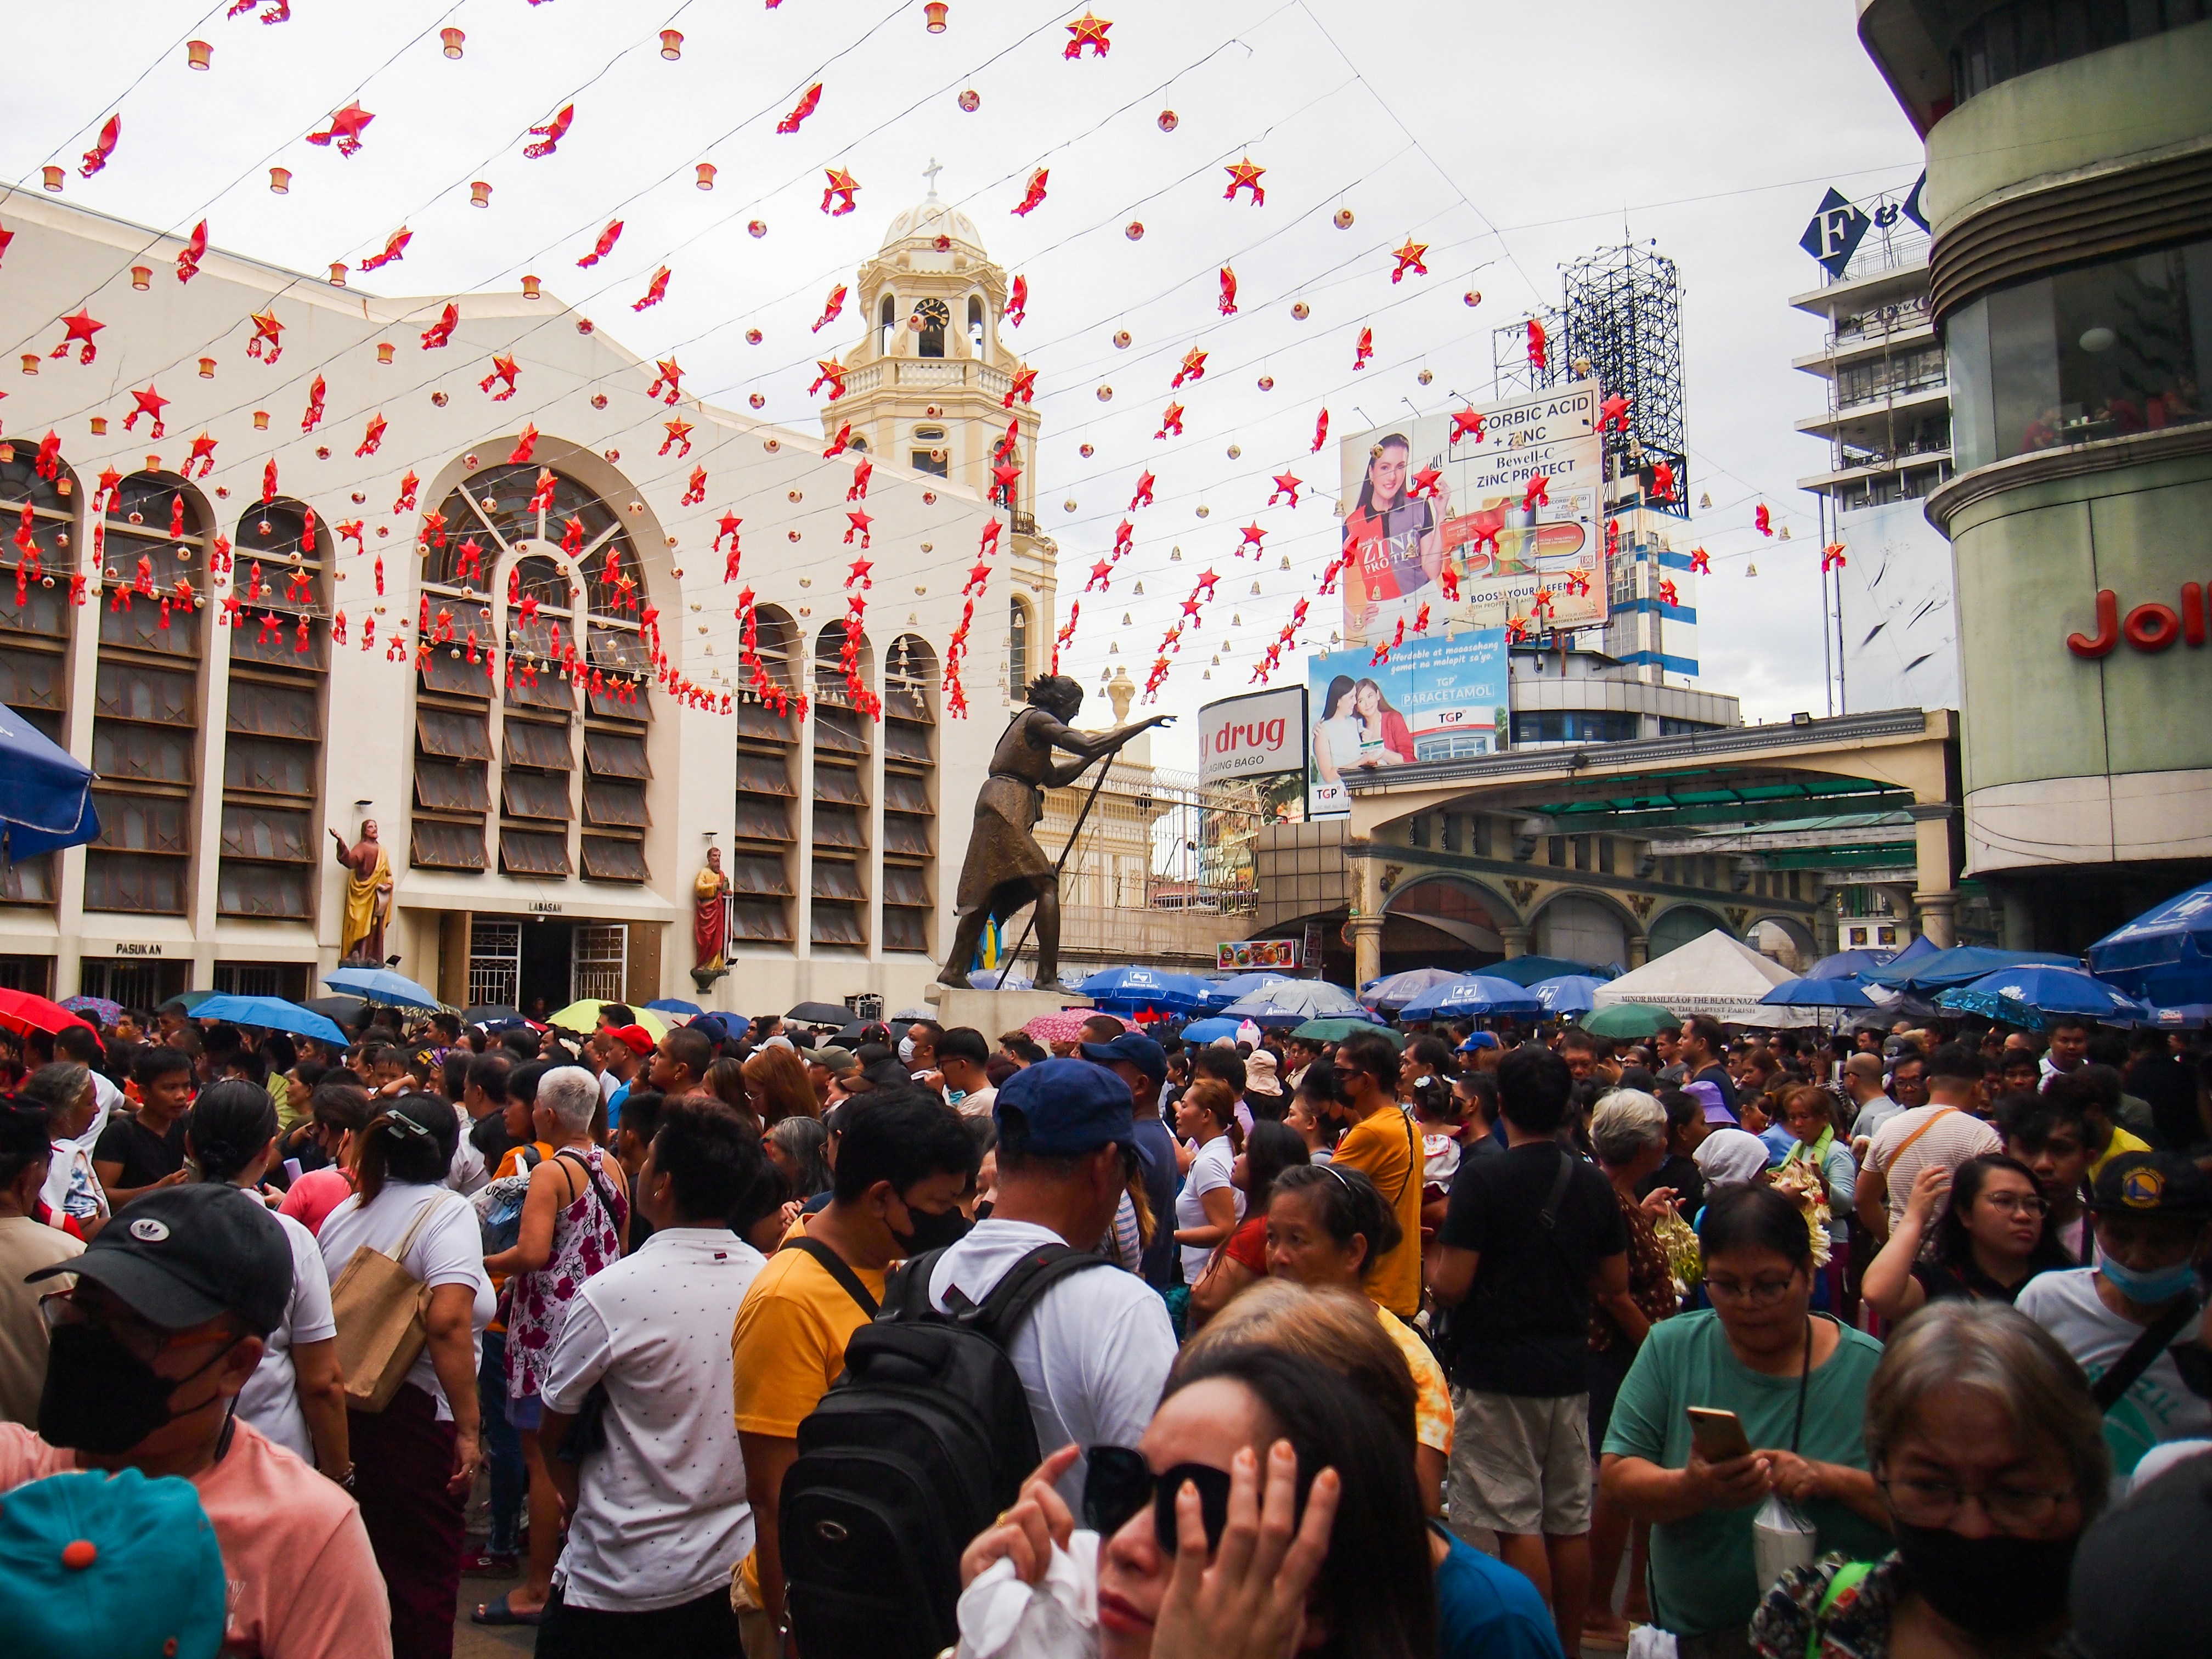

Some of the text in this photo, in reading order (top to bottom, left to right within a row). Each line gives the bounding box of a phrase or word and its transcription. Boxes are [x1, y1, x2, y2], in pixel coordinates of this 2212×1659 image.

[1813, 204, 1898, 261] F &
[1477, 397, 1589, 431] CORBIC ACID
[1508, 426, 1547, 447] ZNC
[1497, 447, 1555, 469] Bewell-C
[1513, 460, 1576, 482] PROTECT
[1471, 592, 1498, 603] BOOS
[1508, 586, 1535, 598] YOUR
[2067, 582, 2212, 657] Jol
[1433, 647, 1442, 656] at
[1446, 642, 1499, 654] maaasahang
[1391, 661, 1417, 675] gamot
[1434, 654, 1465, 667] malapit
[1437, 677, 1454, 687] TGP
[1403, 686, 1493, 706] PARACETAMOL
[1438, 712, 1463, 724] TGP
[1215, 718, 1285, 754] drug
[1234, 755, 1264, 768] BAGO
[1317, 788, 1337, 800] TGP
[529, 902, 562, 912] LABASAN
[116, 943, 162, 955] PASUKAN
